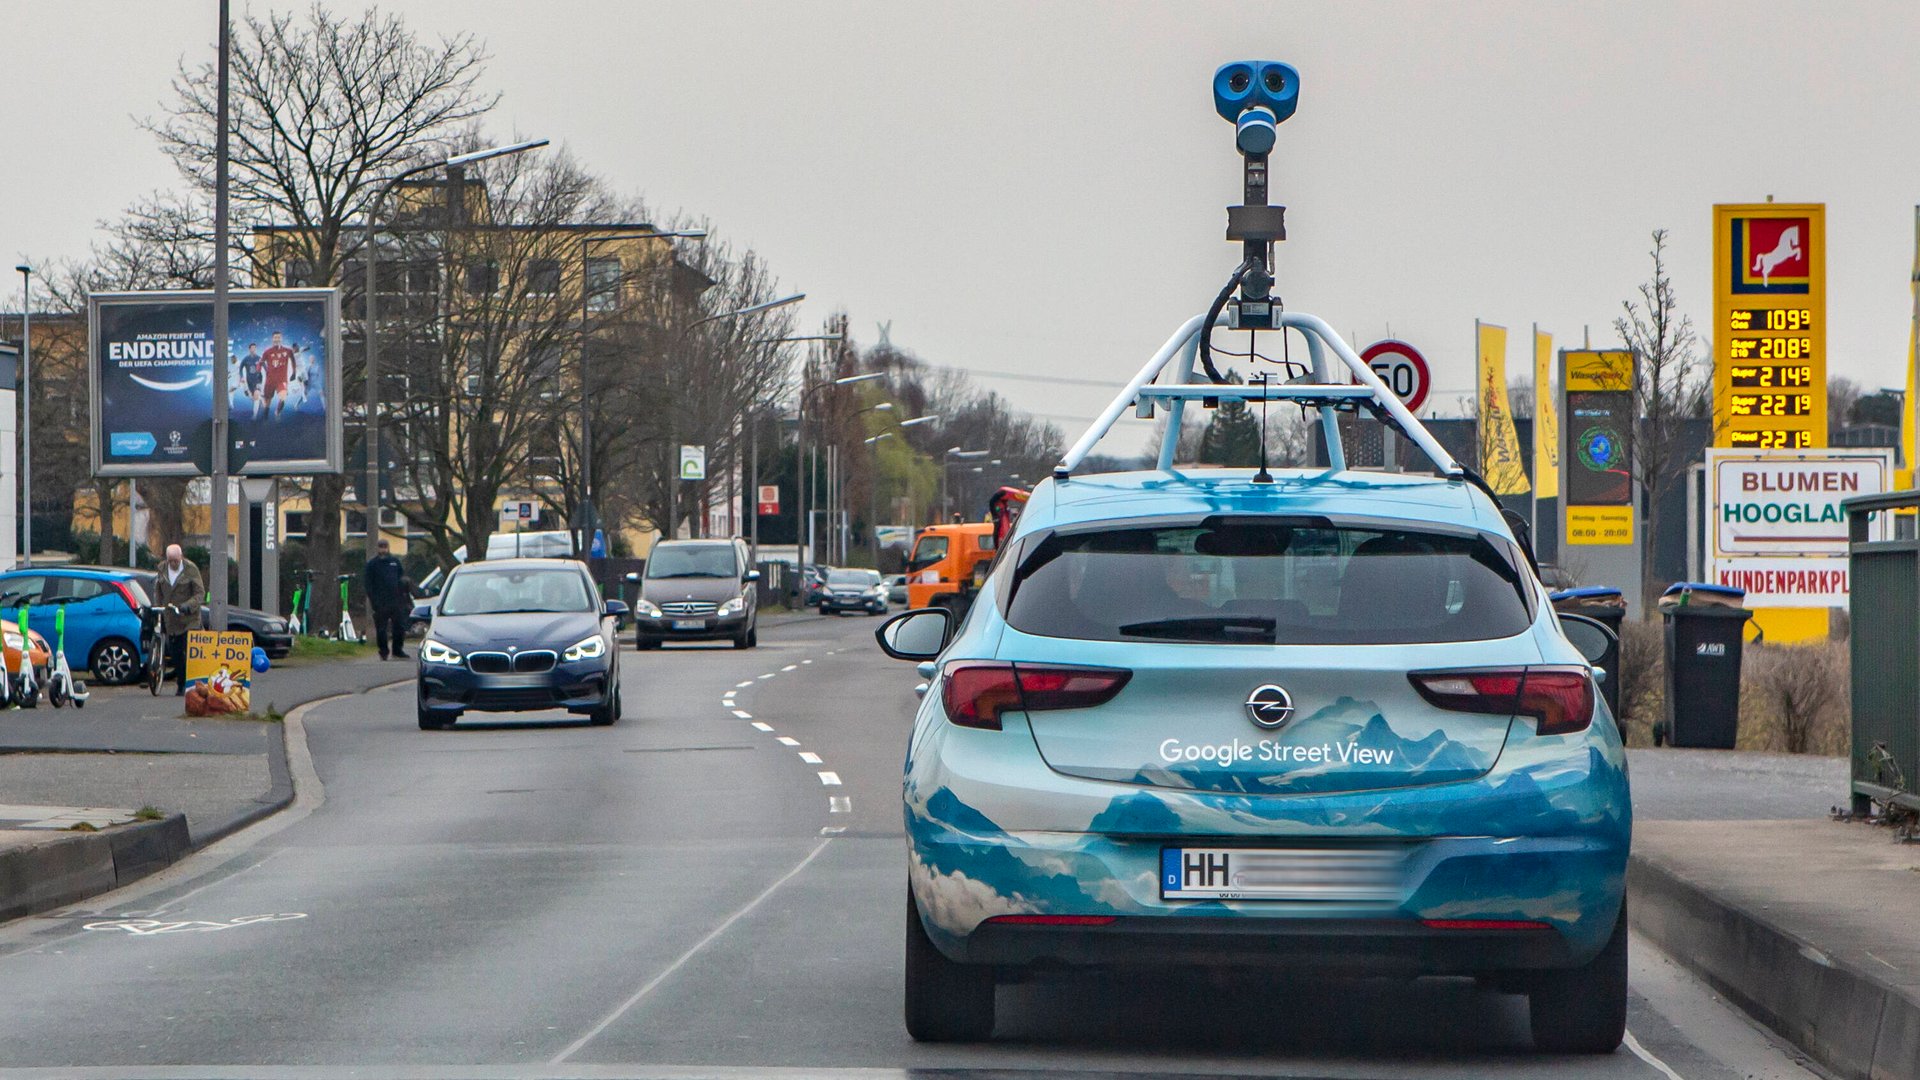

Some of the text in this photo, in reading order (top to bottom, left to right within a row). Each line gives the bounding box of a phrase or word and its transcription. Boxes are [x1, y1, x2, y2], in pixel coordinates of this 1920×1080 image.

[1731, 311, 1752, 321] Auto
[1731, 340, 1757, 349] Super
[1760, 338, 1810, 359] 2089
[1731, 349, 1749, 358] E10
[153, 359, 196, 367] CHAMPIONS
[1731, 368, 1757, 378] Super
[1760, 367, 1810, 387] 2149
[1371, 363, 1413, 398] 50
[1731, 396, 1757, 405] Super
[1760, 395, 1811, 415] 2219
[1731, 432, 1758, 442] Diesel
[1760, 431, 1811, 449] 2219
[1742, 472, 1858, 491] BLUMEN
[190, 633, 249, 646] Hier jeden
[189, 647, 207, 659] Di.
[225, 648, 248, 660] Do.
[1160, 739, 1394, 767] Google Street View
[1168, 875, 1176, 885] D
[1184, 853, 1229, 886] HH
